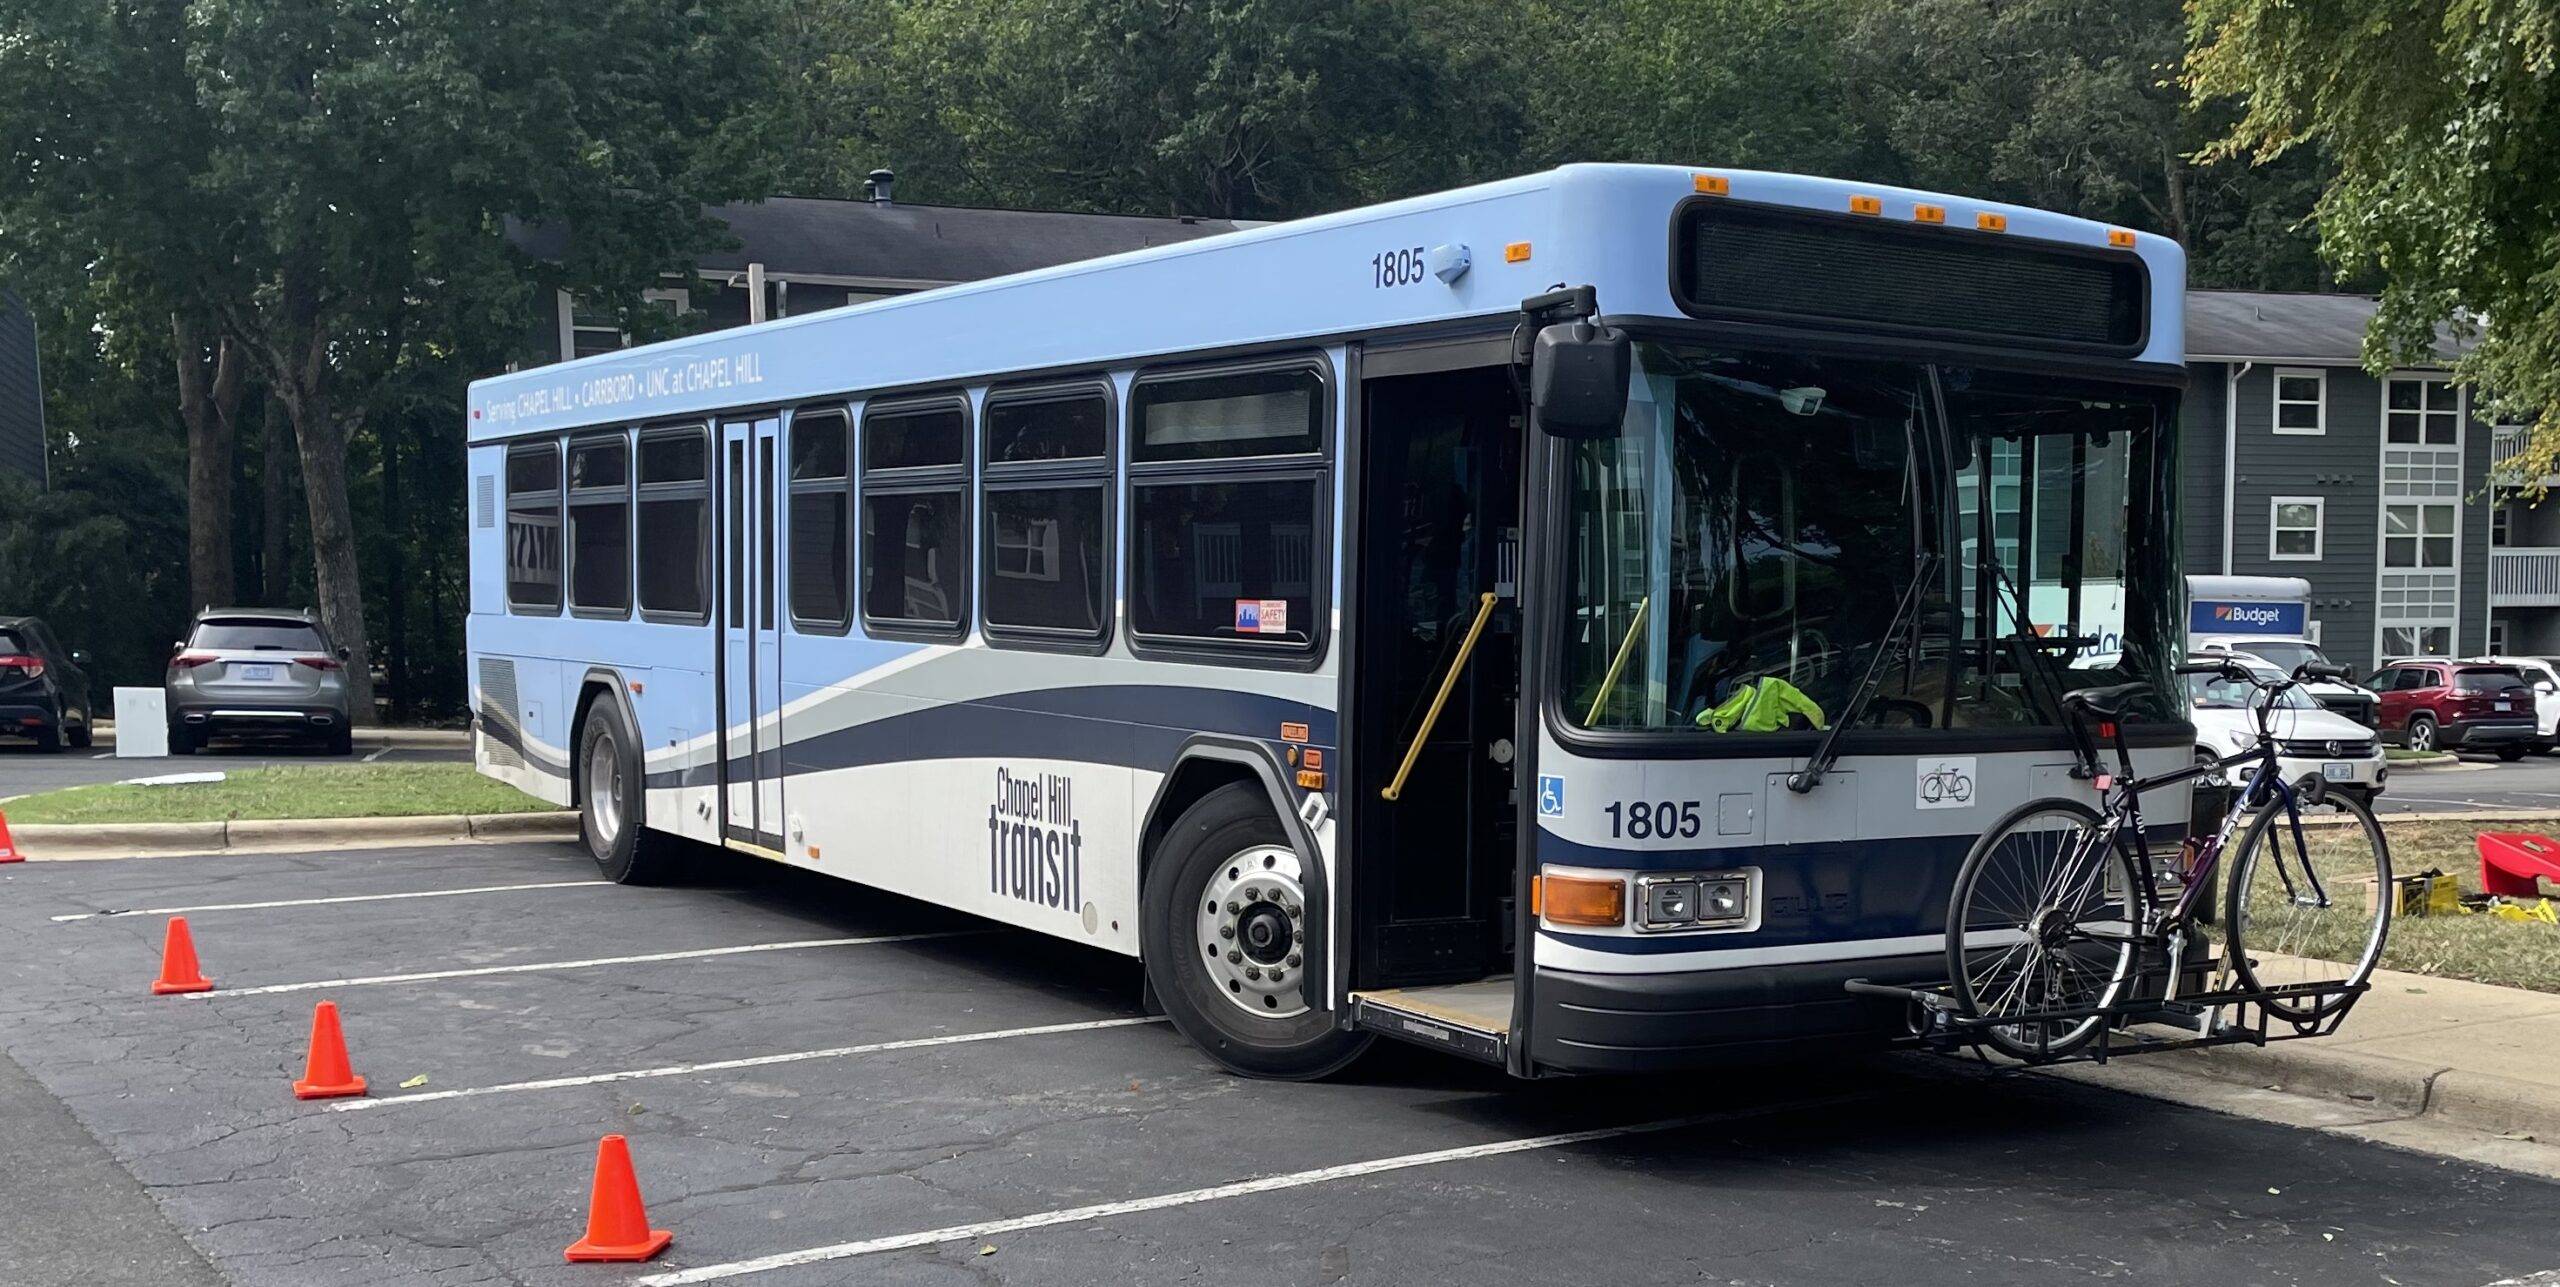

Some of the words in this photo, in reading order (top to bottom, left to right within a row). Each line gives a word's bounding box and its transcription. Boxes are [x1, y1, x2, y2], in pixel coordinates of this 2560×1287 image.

[1372, 247, 1424, 289] 1805
[487, 399, 516, 425] Serving
[518, 389, 548, 418] CHAPEL
[552, 386, 572, 411] HILL
[582, 374, 635, 407] CARRBORO
[646, 367, 669, 398] UNC
[672, 369, 684, 394] at
[687, 357, 732, 392] CHAPEL
[735, 352, 763, 385] HILL
[2233, 607, 2280, 625] Budget
[997, 766, 1043, 823] Chapel
[1048, 774, 1071, 827] Hill
[1604, 801, 1700, 839] 1805
[989, 804, 1082, 914] transit
